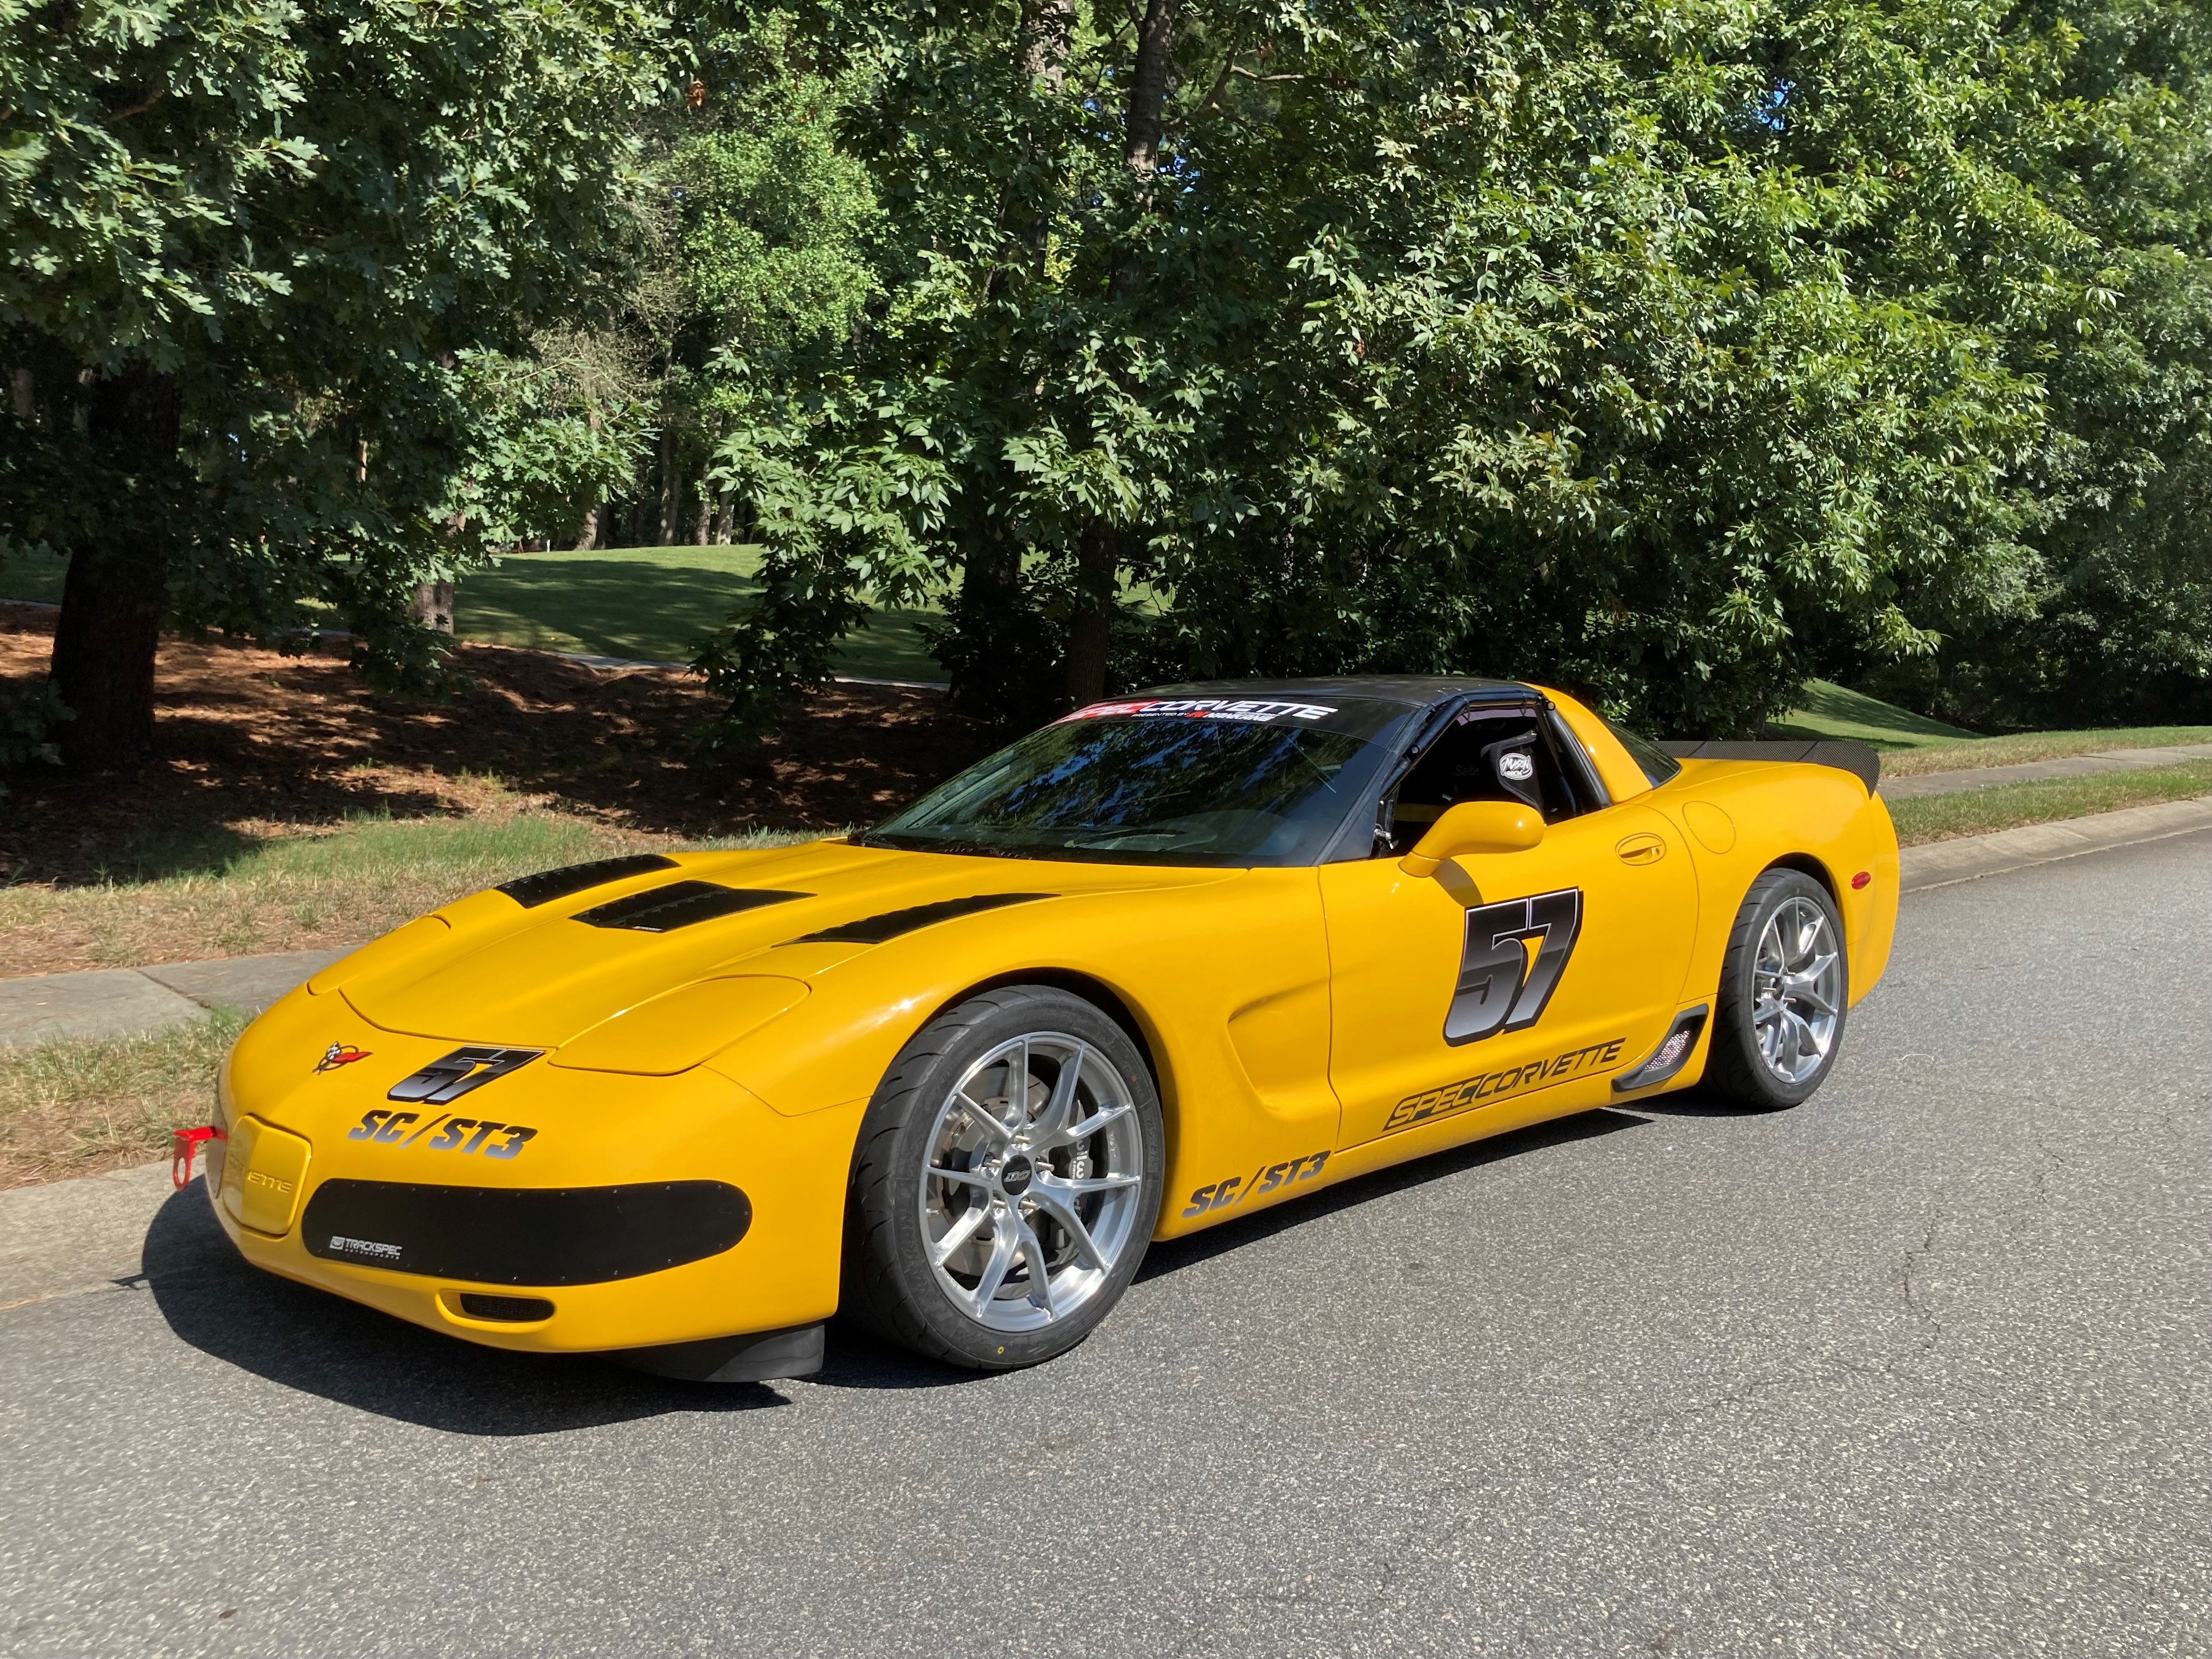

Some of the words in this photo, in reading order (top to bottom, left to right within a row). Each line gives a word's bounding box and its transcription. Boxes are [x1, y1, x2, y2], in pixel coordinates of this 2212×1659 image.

[1442, 885, 1584, 1047] 57
[387, 1045, 546, 1106] 57
[348, 1109, 538, 1160] SC/ST3
[1182, 1150, 1331, 1218] SC/ST3
[345, 1238, 403, 1256] TRACKSPEC
